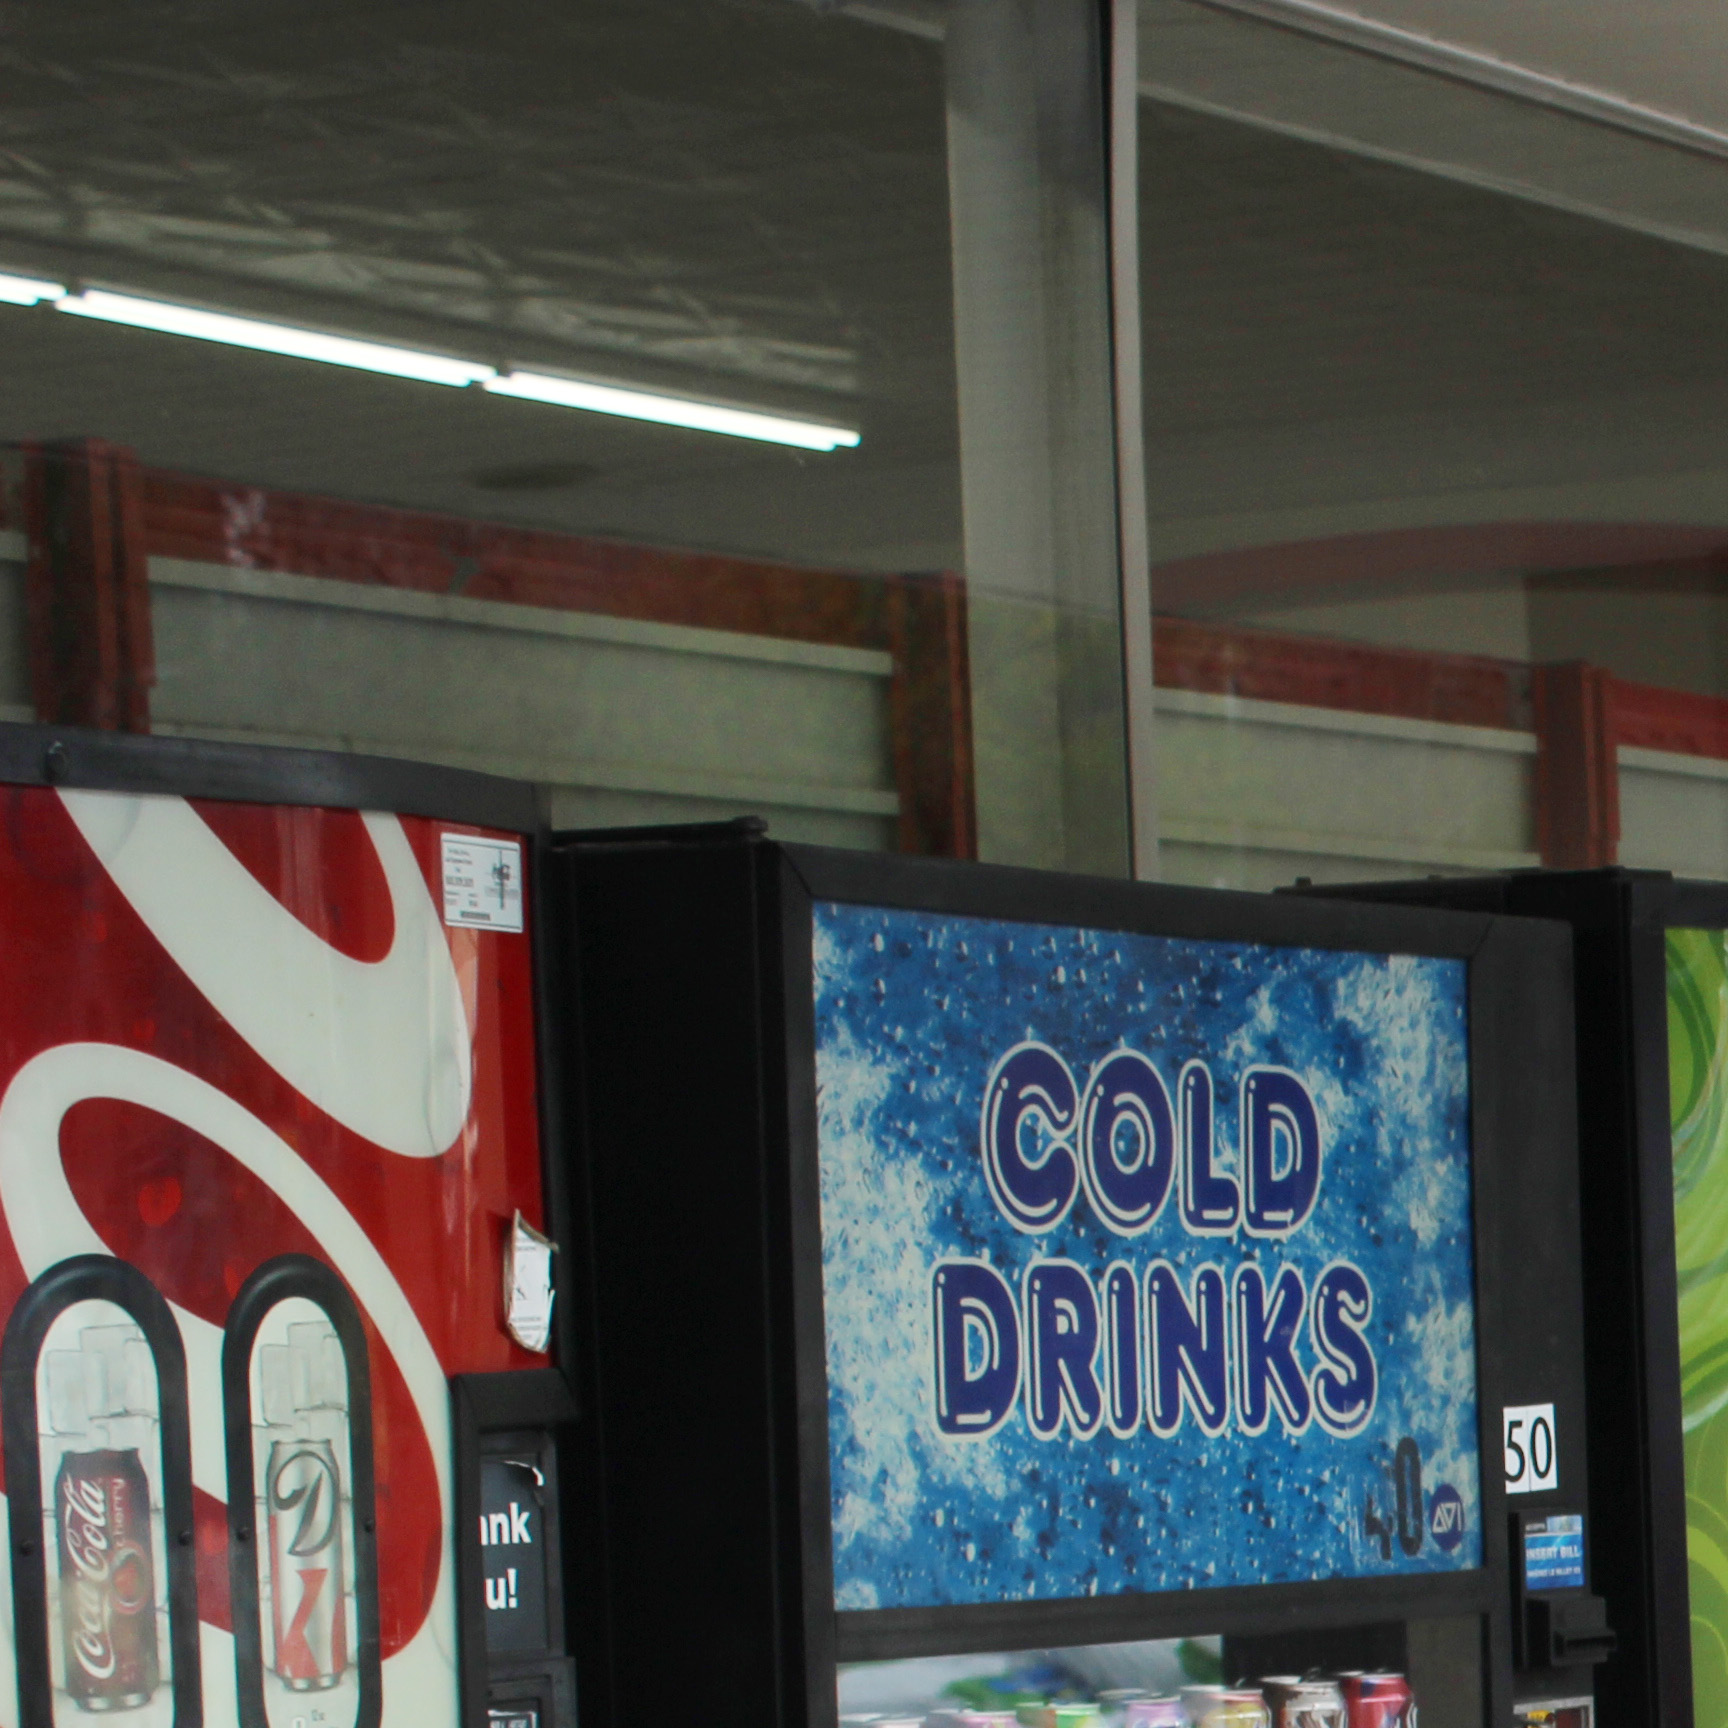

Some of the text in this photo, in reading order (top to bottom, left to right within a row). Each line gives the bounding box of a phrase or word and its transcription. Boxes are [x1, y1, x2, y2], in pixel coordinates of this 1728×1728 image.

[981, 1041, 1322, 1238] COLD
[932, 1258, 1379, 1440] DRINKS
[1503, 1416, 1552, 1483] 50
